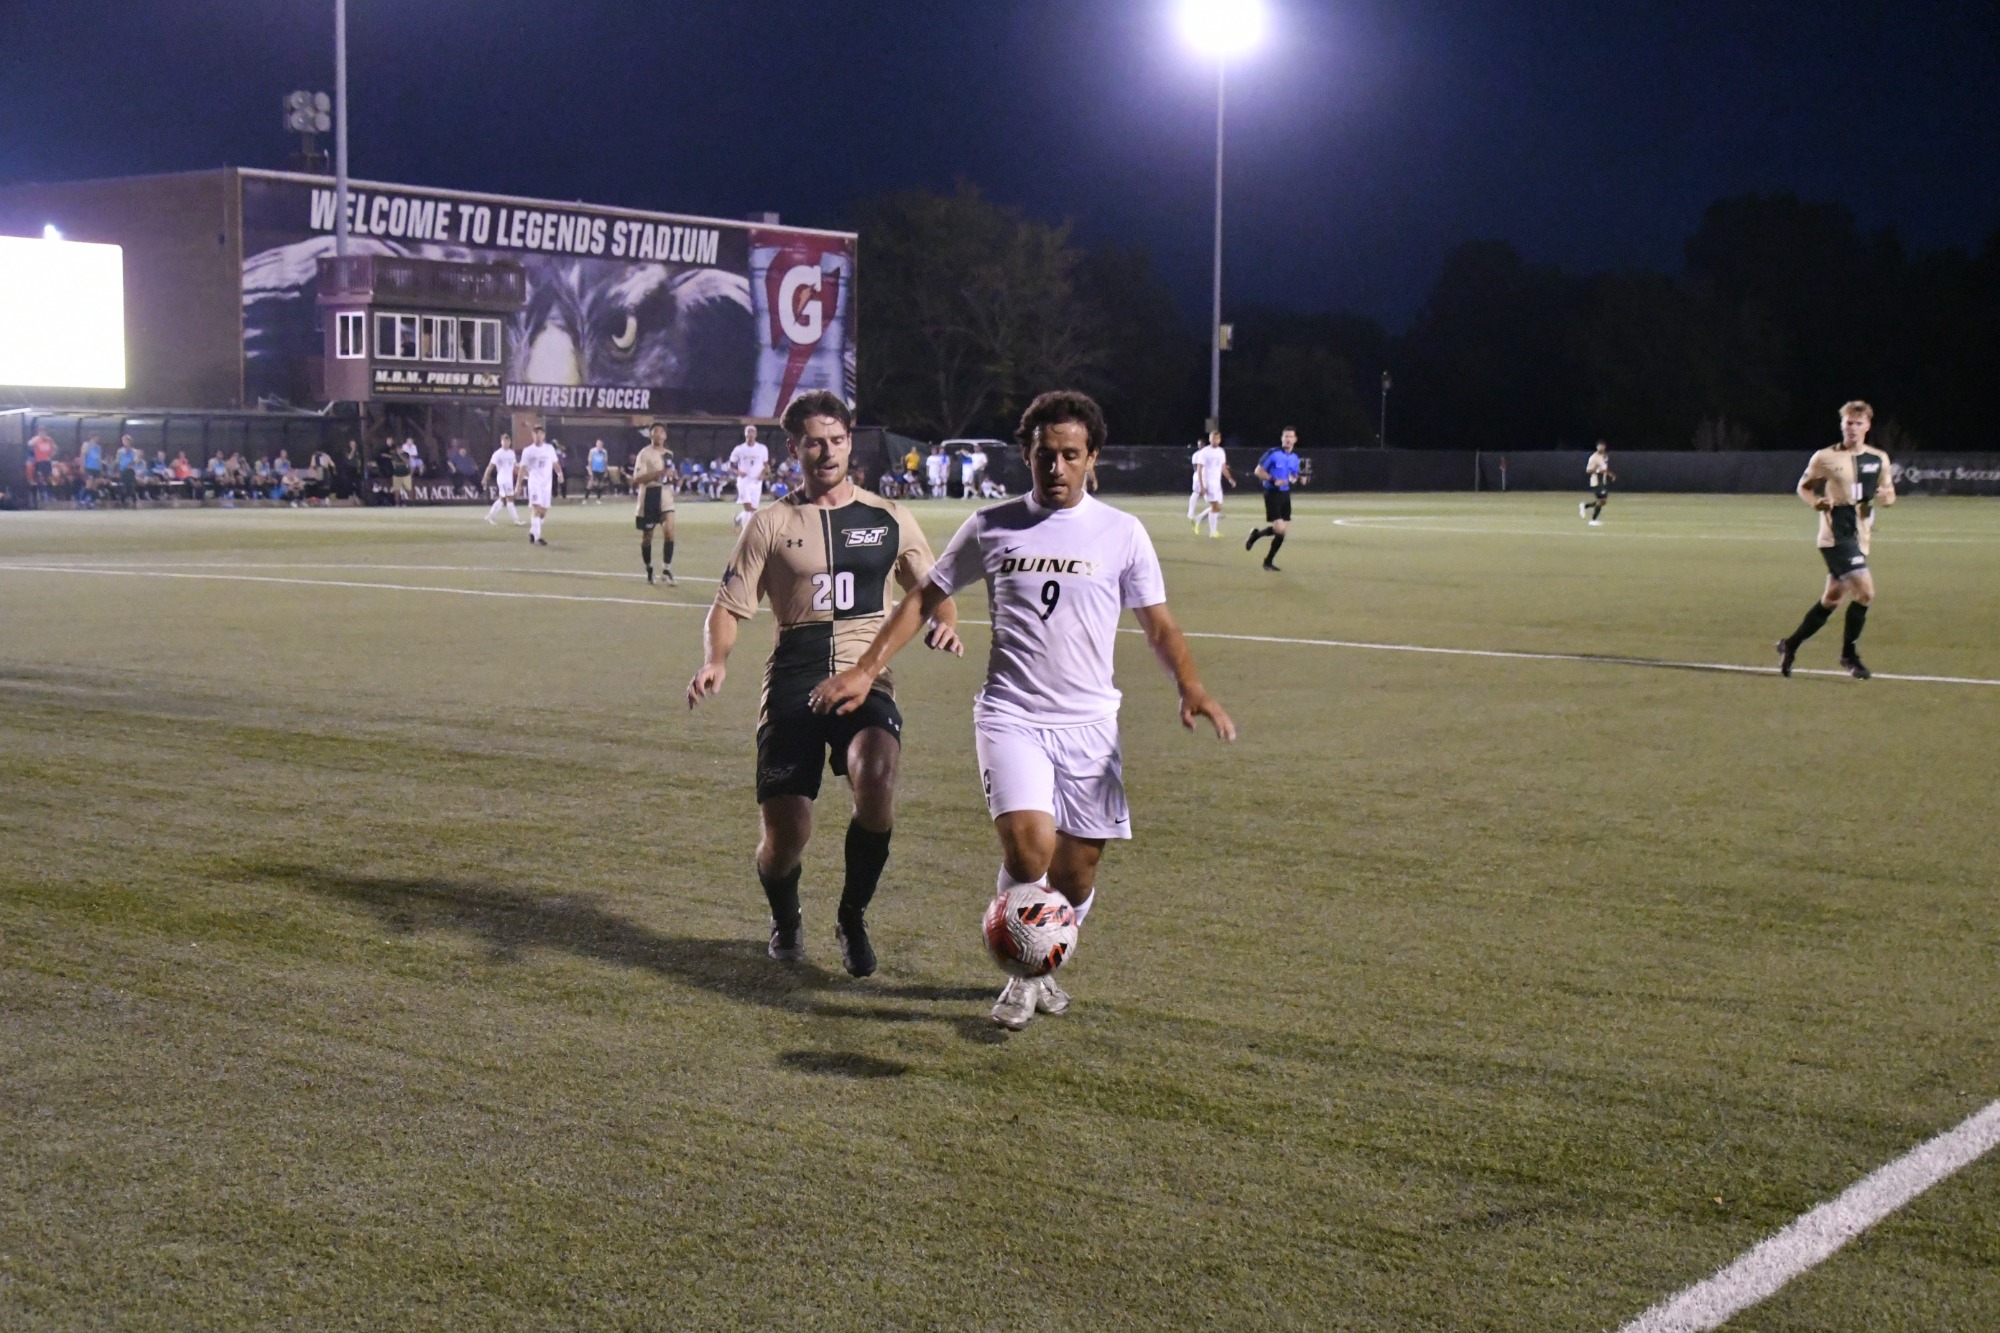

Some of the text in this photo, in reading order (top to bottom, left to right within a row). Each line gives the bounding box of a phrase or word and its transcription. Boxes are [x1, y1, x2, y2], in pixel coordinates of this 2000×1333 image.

[310, 189, 719, 265] WELCOME TO LEGENDS STADIUM
[778, 265, 822, 344] G
[426, 372, 470, 386] PRESS
[505, 385, 596, 408] UNIVERSITY
[597, 388, 651, 409] SOCCER
[847, 528, 887, 547] S&T
[1001, 557, 1099, 577] QUINCY
[811, 571, 855, 611] 20
[1041, 580, 1060, 620] 9
